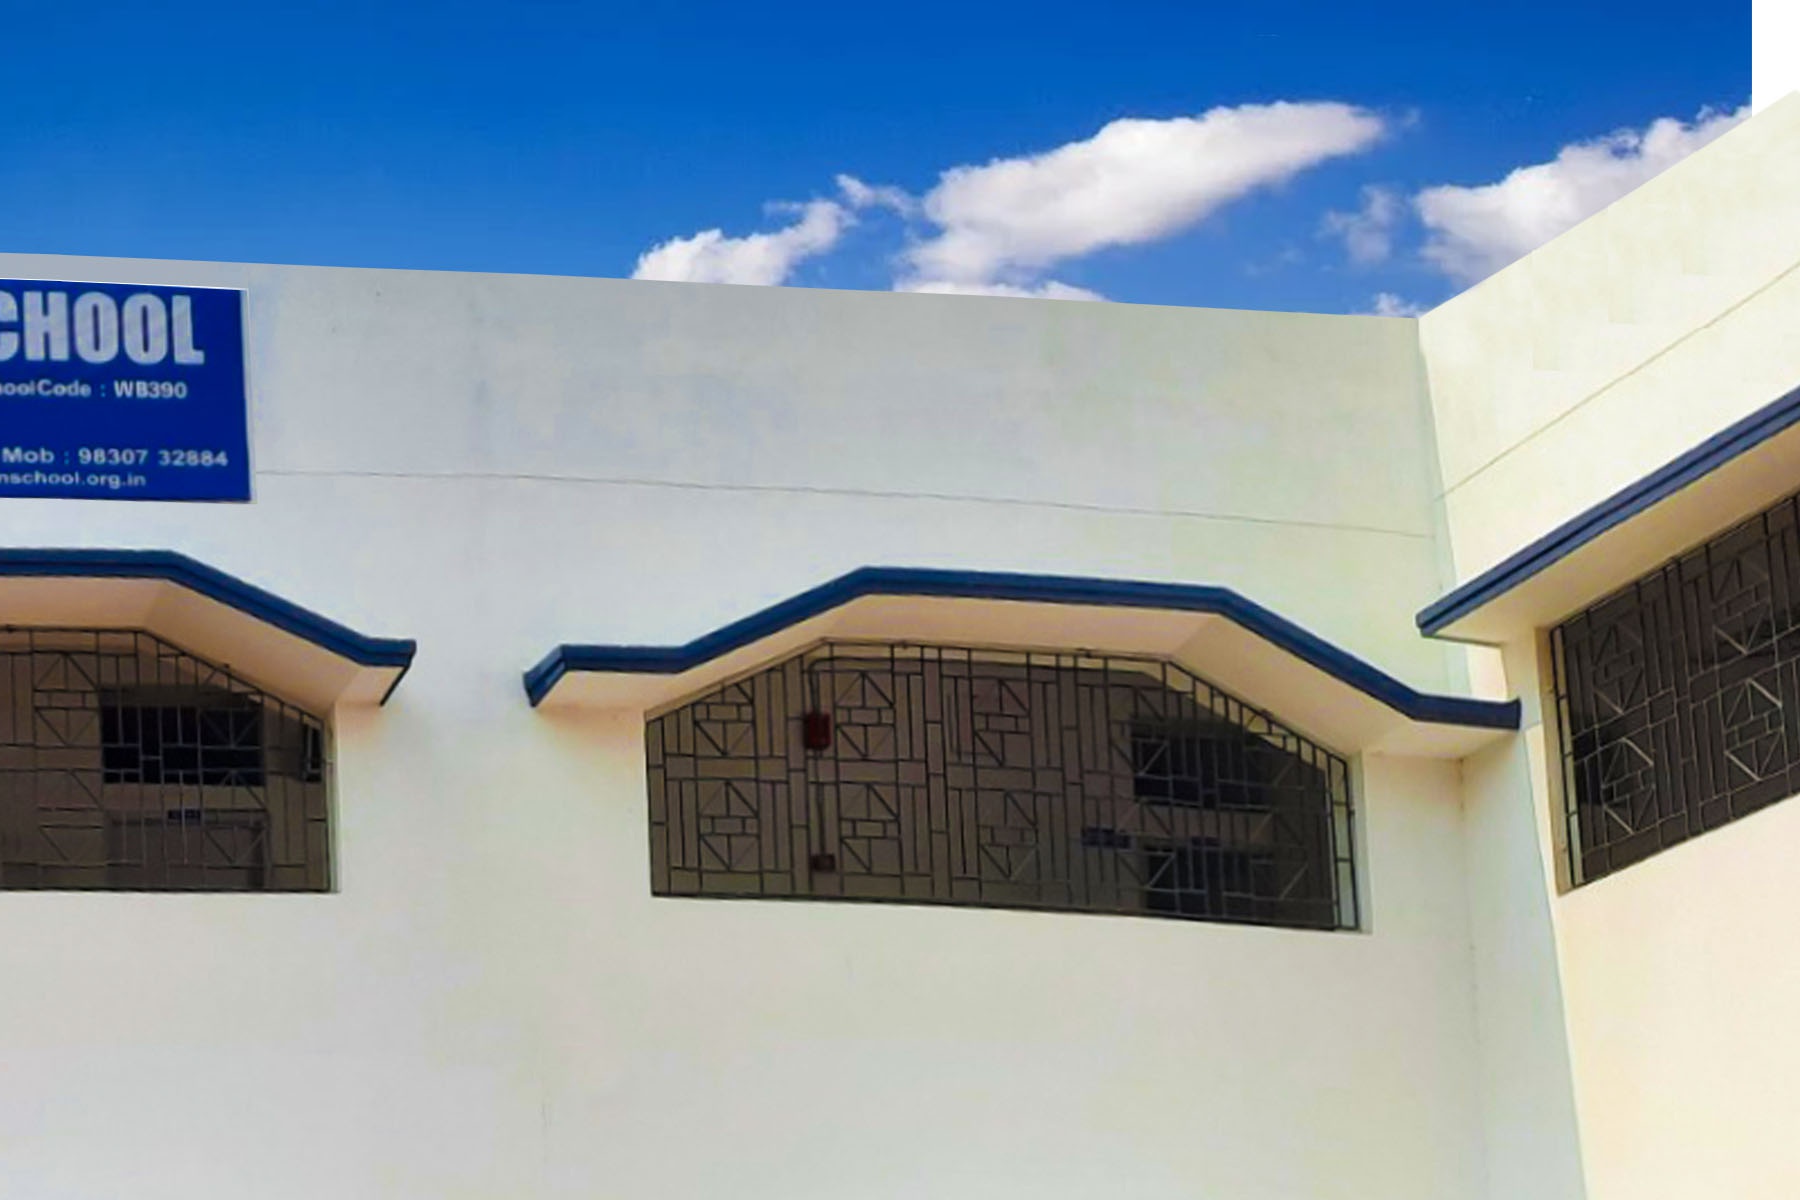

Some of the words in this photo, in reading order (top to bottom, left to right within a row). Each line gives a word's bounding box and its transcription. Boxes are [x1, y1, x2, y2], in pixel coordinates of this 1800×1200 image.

[114, 380, 187, 399] WB390
[2, 447, 54, 463] Mob
[78, 448, 148, 465] 98307
[159, 450, 228, 467] 32884
